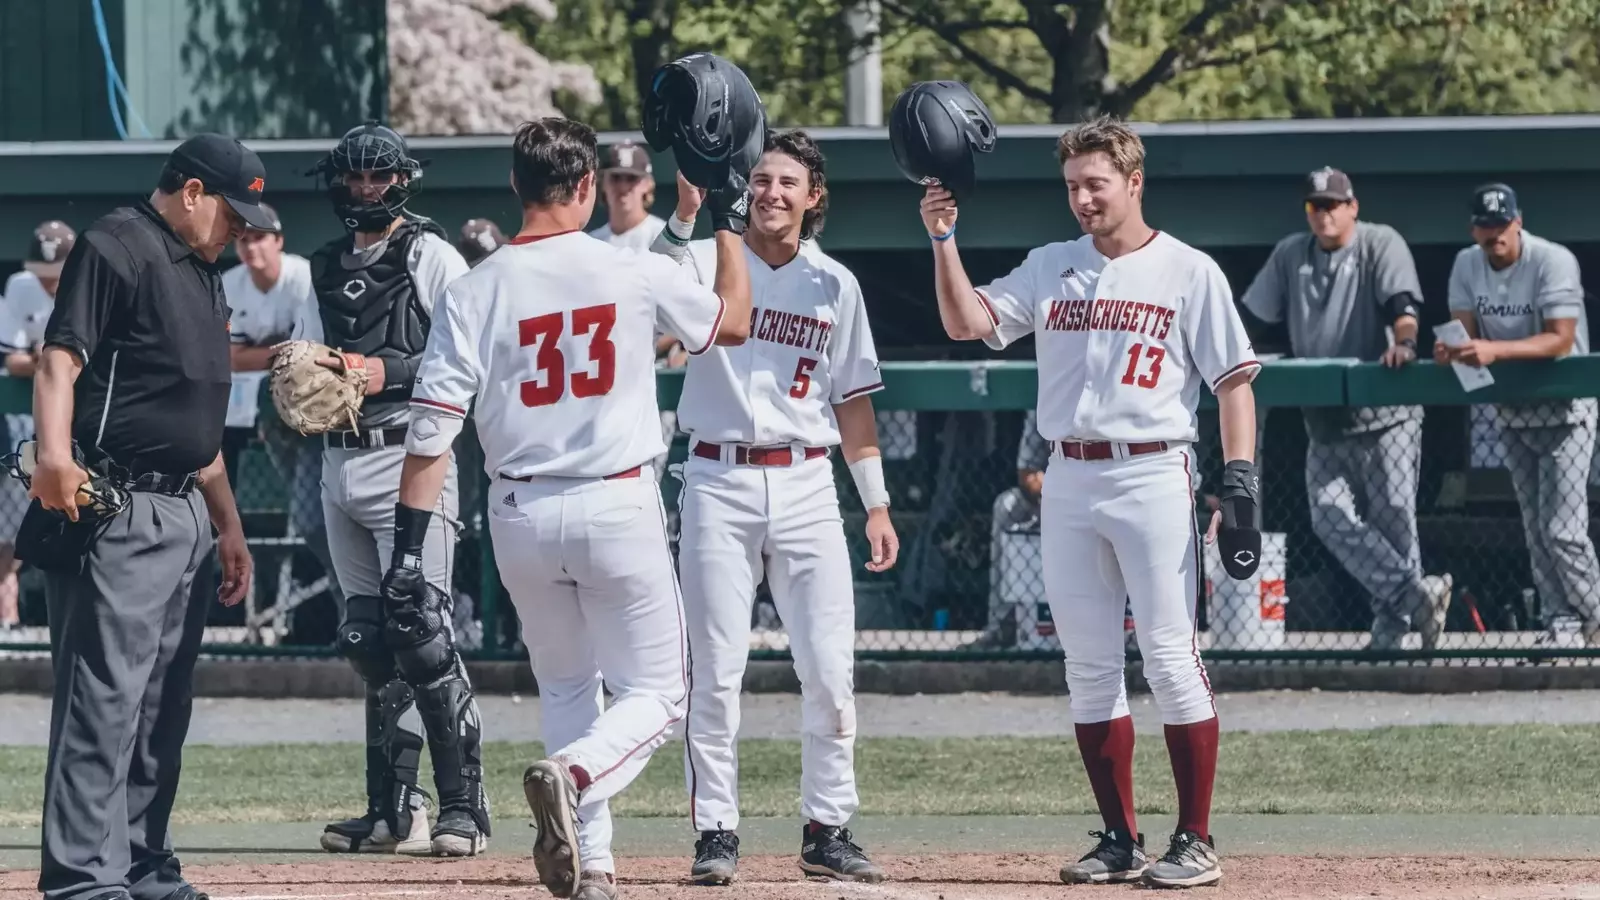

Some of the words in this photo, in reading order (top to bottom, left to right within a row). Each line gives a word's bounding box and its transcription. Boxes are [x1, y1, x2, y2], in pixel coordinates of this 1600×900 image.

[1045, 298, 1176, 341] MASSACHUSETTS
[518, 302, 616, 408] 33
[789, 356, 819, 400] 5
[1120, 342, 1166, 390] 13
